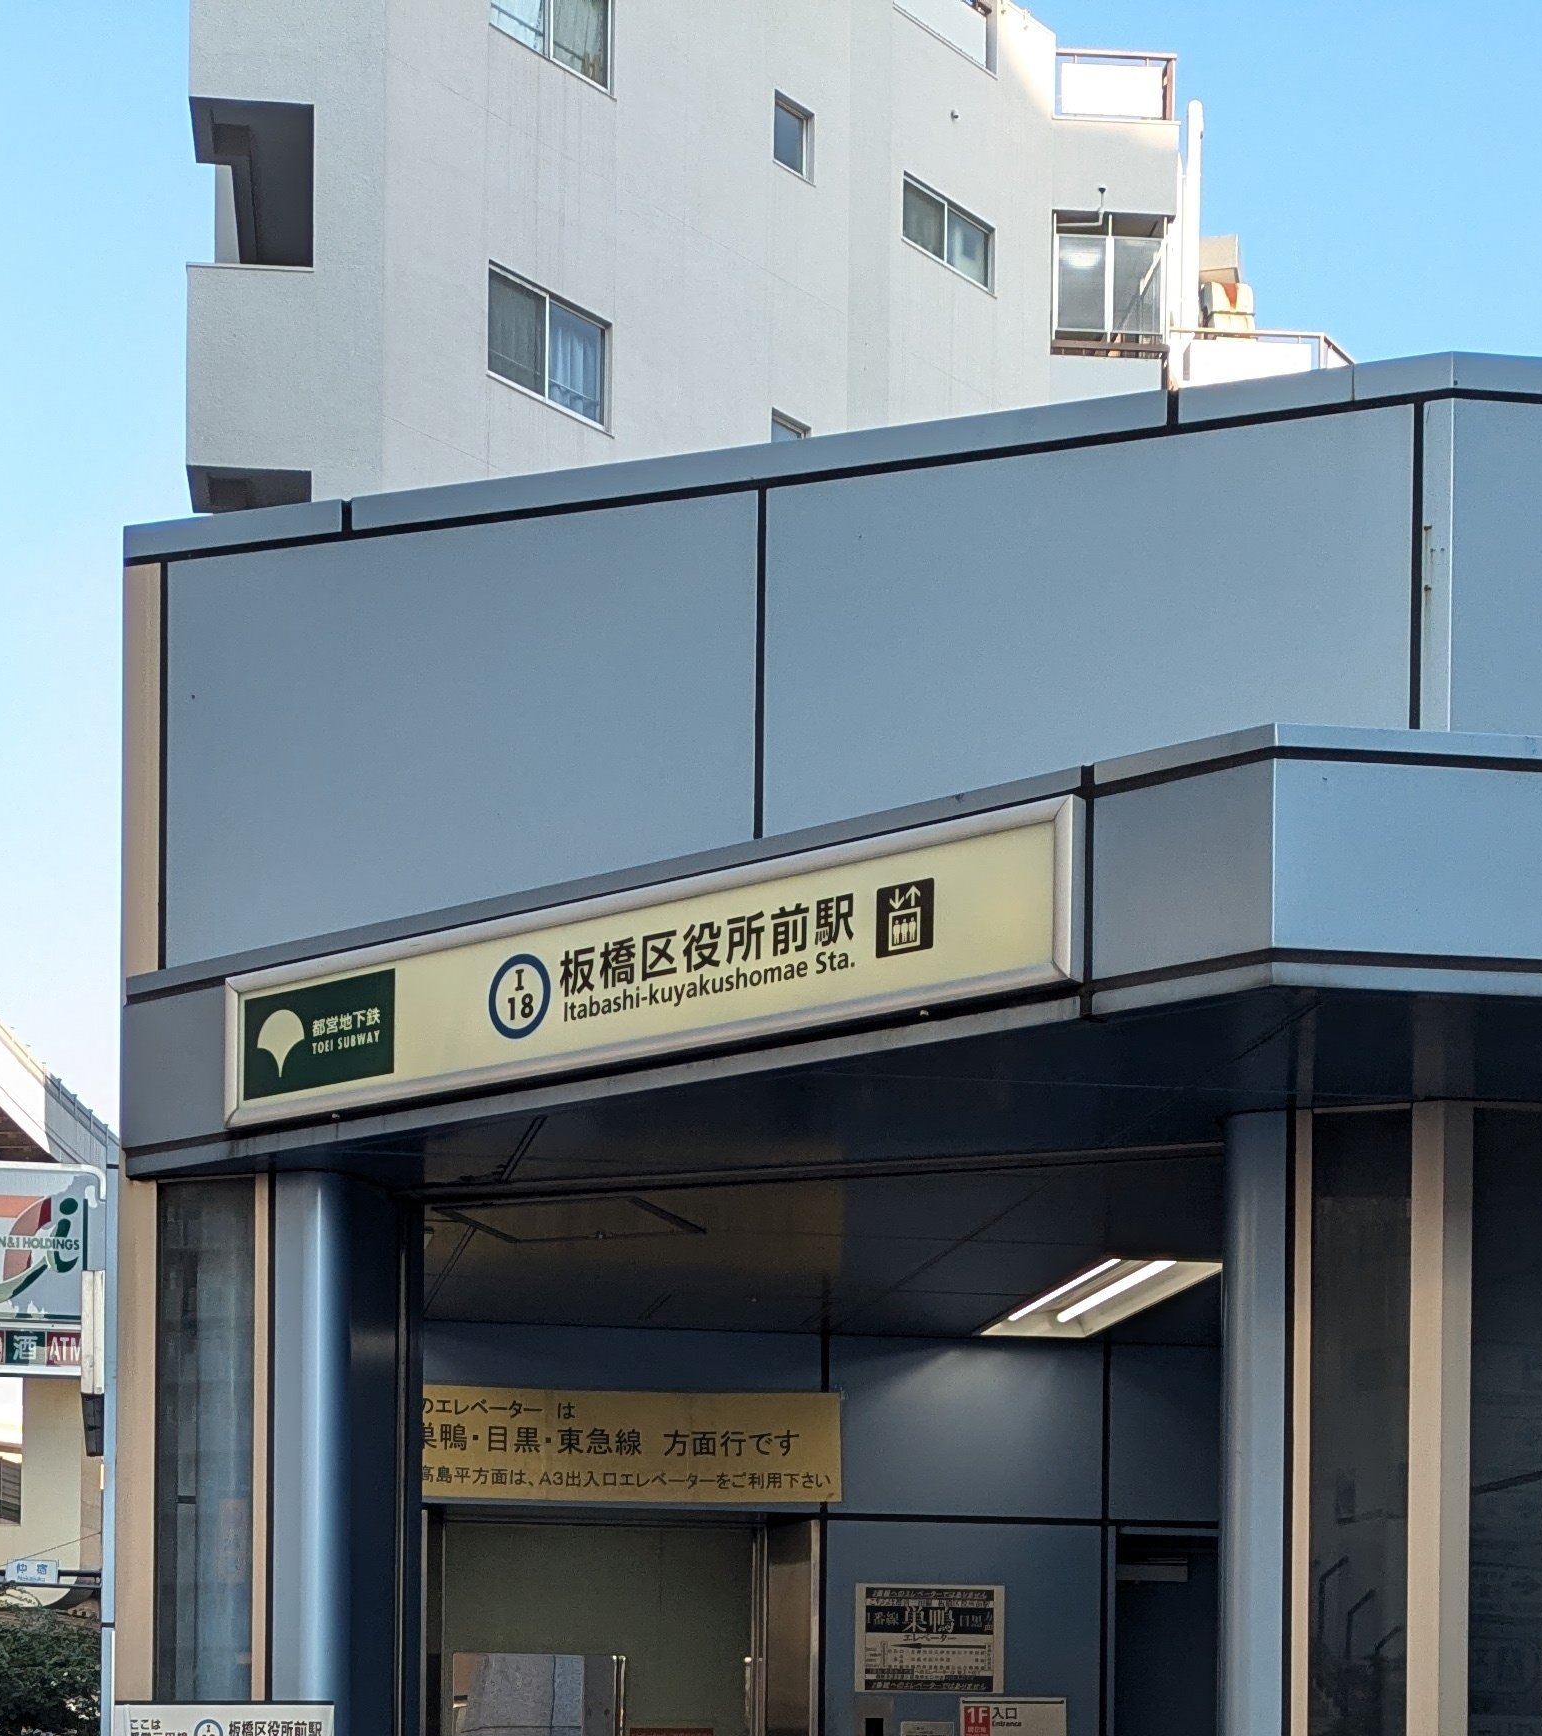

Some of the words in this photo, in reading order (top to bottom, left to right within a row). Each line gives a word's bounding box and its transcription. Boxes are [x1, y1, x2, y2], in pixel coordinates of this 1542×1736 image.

[560, 892, 854, 997] 板橋区役所前駅
[563, 959, 808, 1023] Itabashi-kuyakushomae
[815, 949, 856, 975] Sta.
[507, 993, 535, 1021] 18
[312, 1007, 381, 1037] 都営地下鉄
[312, 1040, 334, 1055] TOEI
[337, 1030, 381, 1050] SUBWAY
[23, 1236, 80, 1251] HOLDINGS
[12, 1334, 39, 1361] 酒
[557, 1401, 576, 1420] は
[664, 1428, 800, 1457] 方面行です
[902, 1605, 955, 1633] 巣鴨
[902, 1634, 957, 1642] エレベーター
[130, 1719, 161, 1730] ここは
[967, 1707, 989, 1724] 1F
[992, 1707, 1018, 1720] 入口
